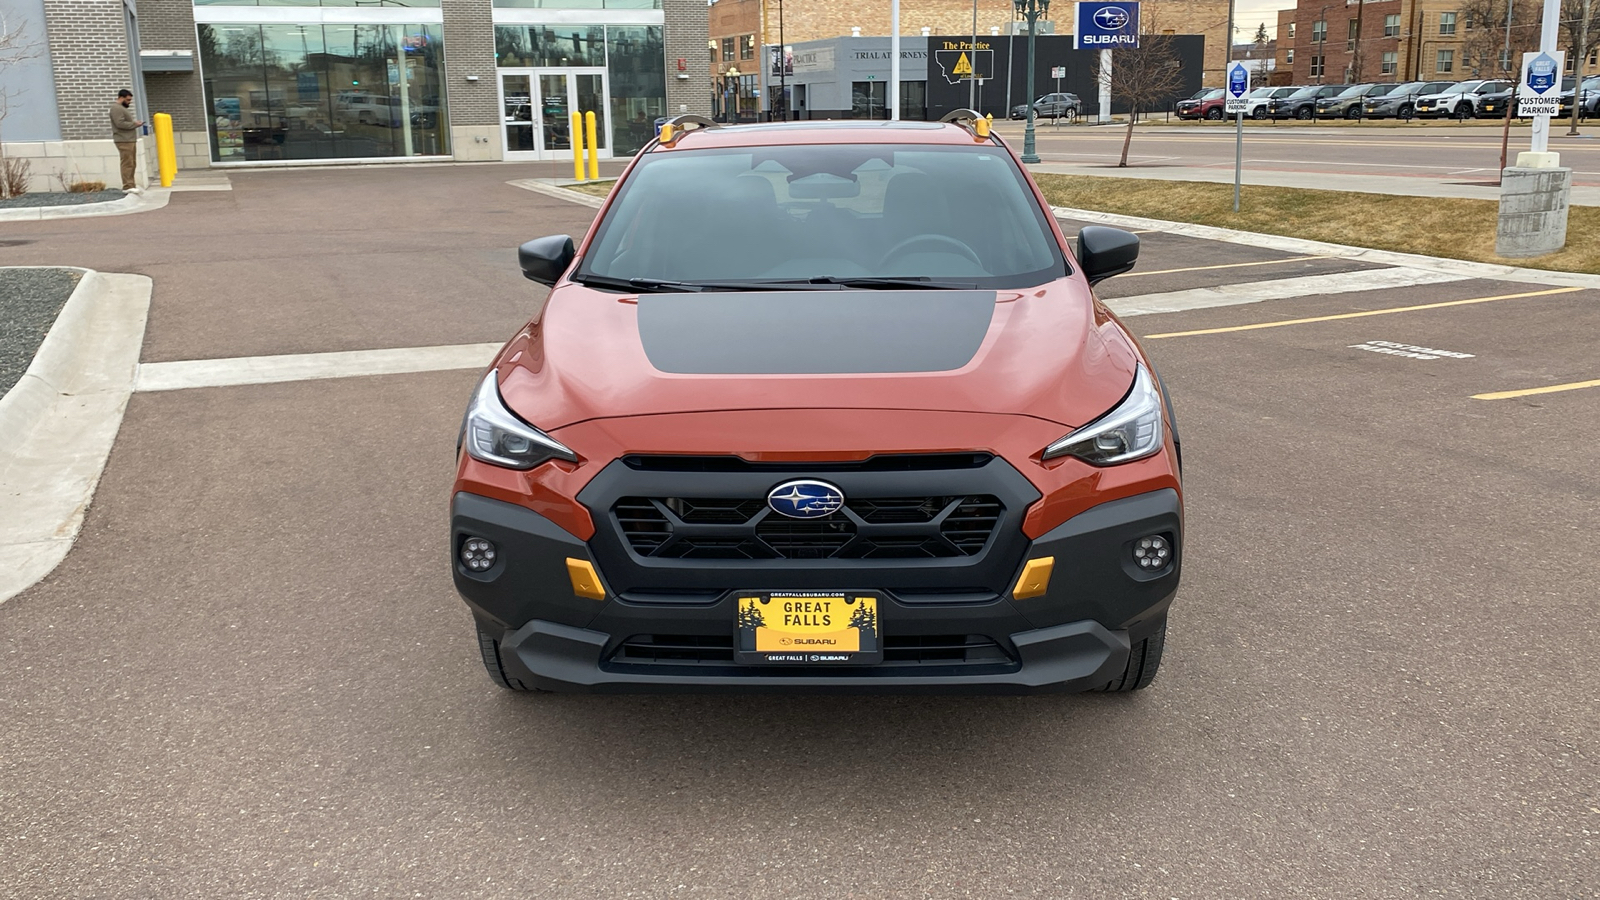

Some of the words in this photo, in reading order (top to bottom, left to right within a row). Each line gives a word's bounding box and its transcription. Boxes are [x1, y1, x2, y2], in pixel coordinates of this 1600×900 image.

[1083, 34, 1135, 44] SUBARU
[943, 41, 959, 50] The
[960, 41, 990, 50] Pratice
[855, 51, 880, 59] TRIAL
[1520, 97, 1561, 105] CUSTOMER
[1521, 106, 1556, 114] PARKING
[783, 602, 831, 613] GREAT
[784, 614, 832, 627] FALLS
